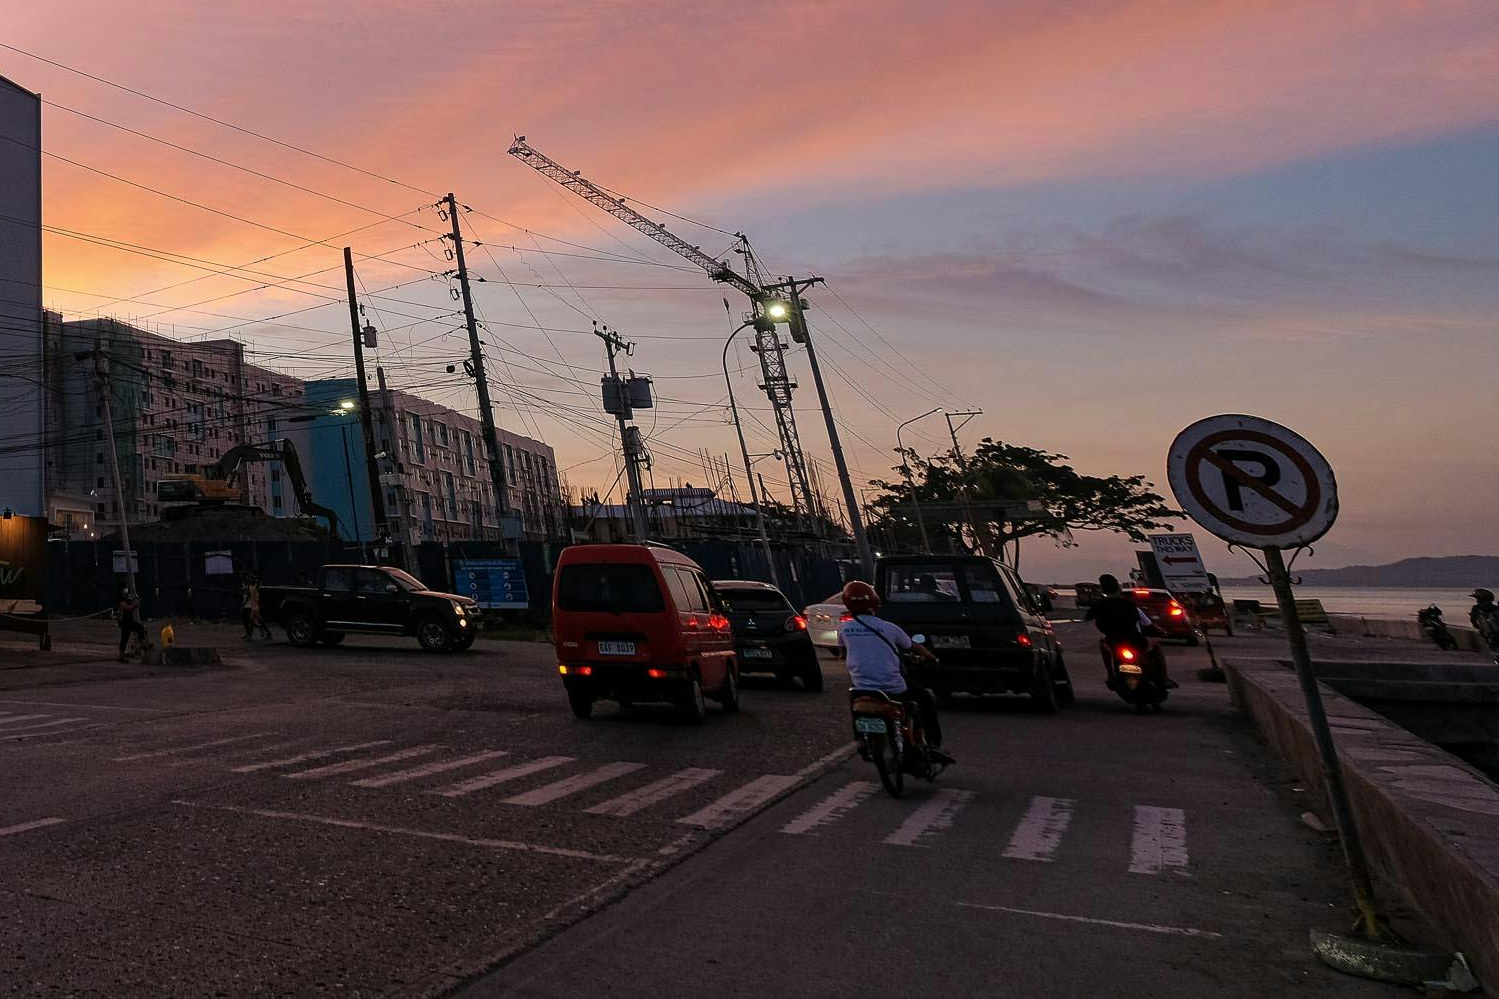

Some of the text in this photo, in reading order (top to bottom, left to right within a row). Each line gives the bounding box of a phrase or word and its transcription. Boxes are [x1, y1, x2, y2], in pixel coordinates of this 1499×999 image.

[1216, 449, 1280, 511] P
[1151, 535, 1194, 546] TRUCKS
[1155, 545, 1193, 553] THIS WAY
